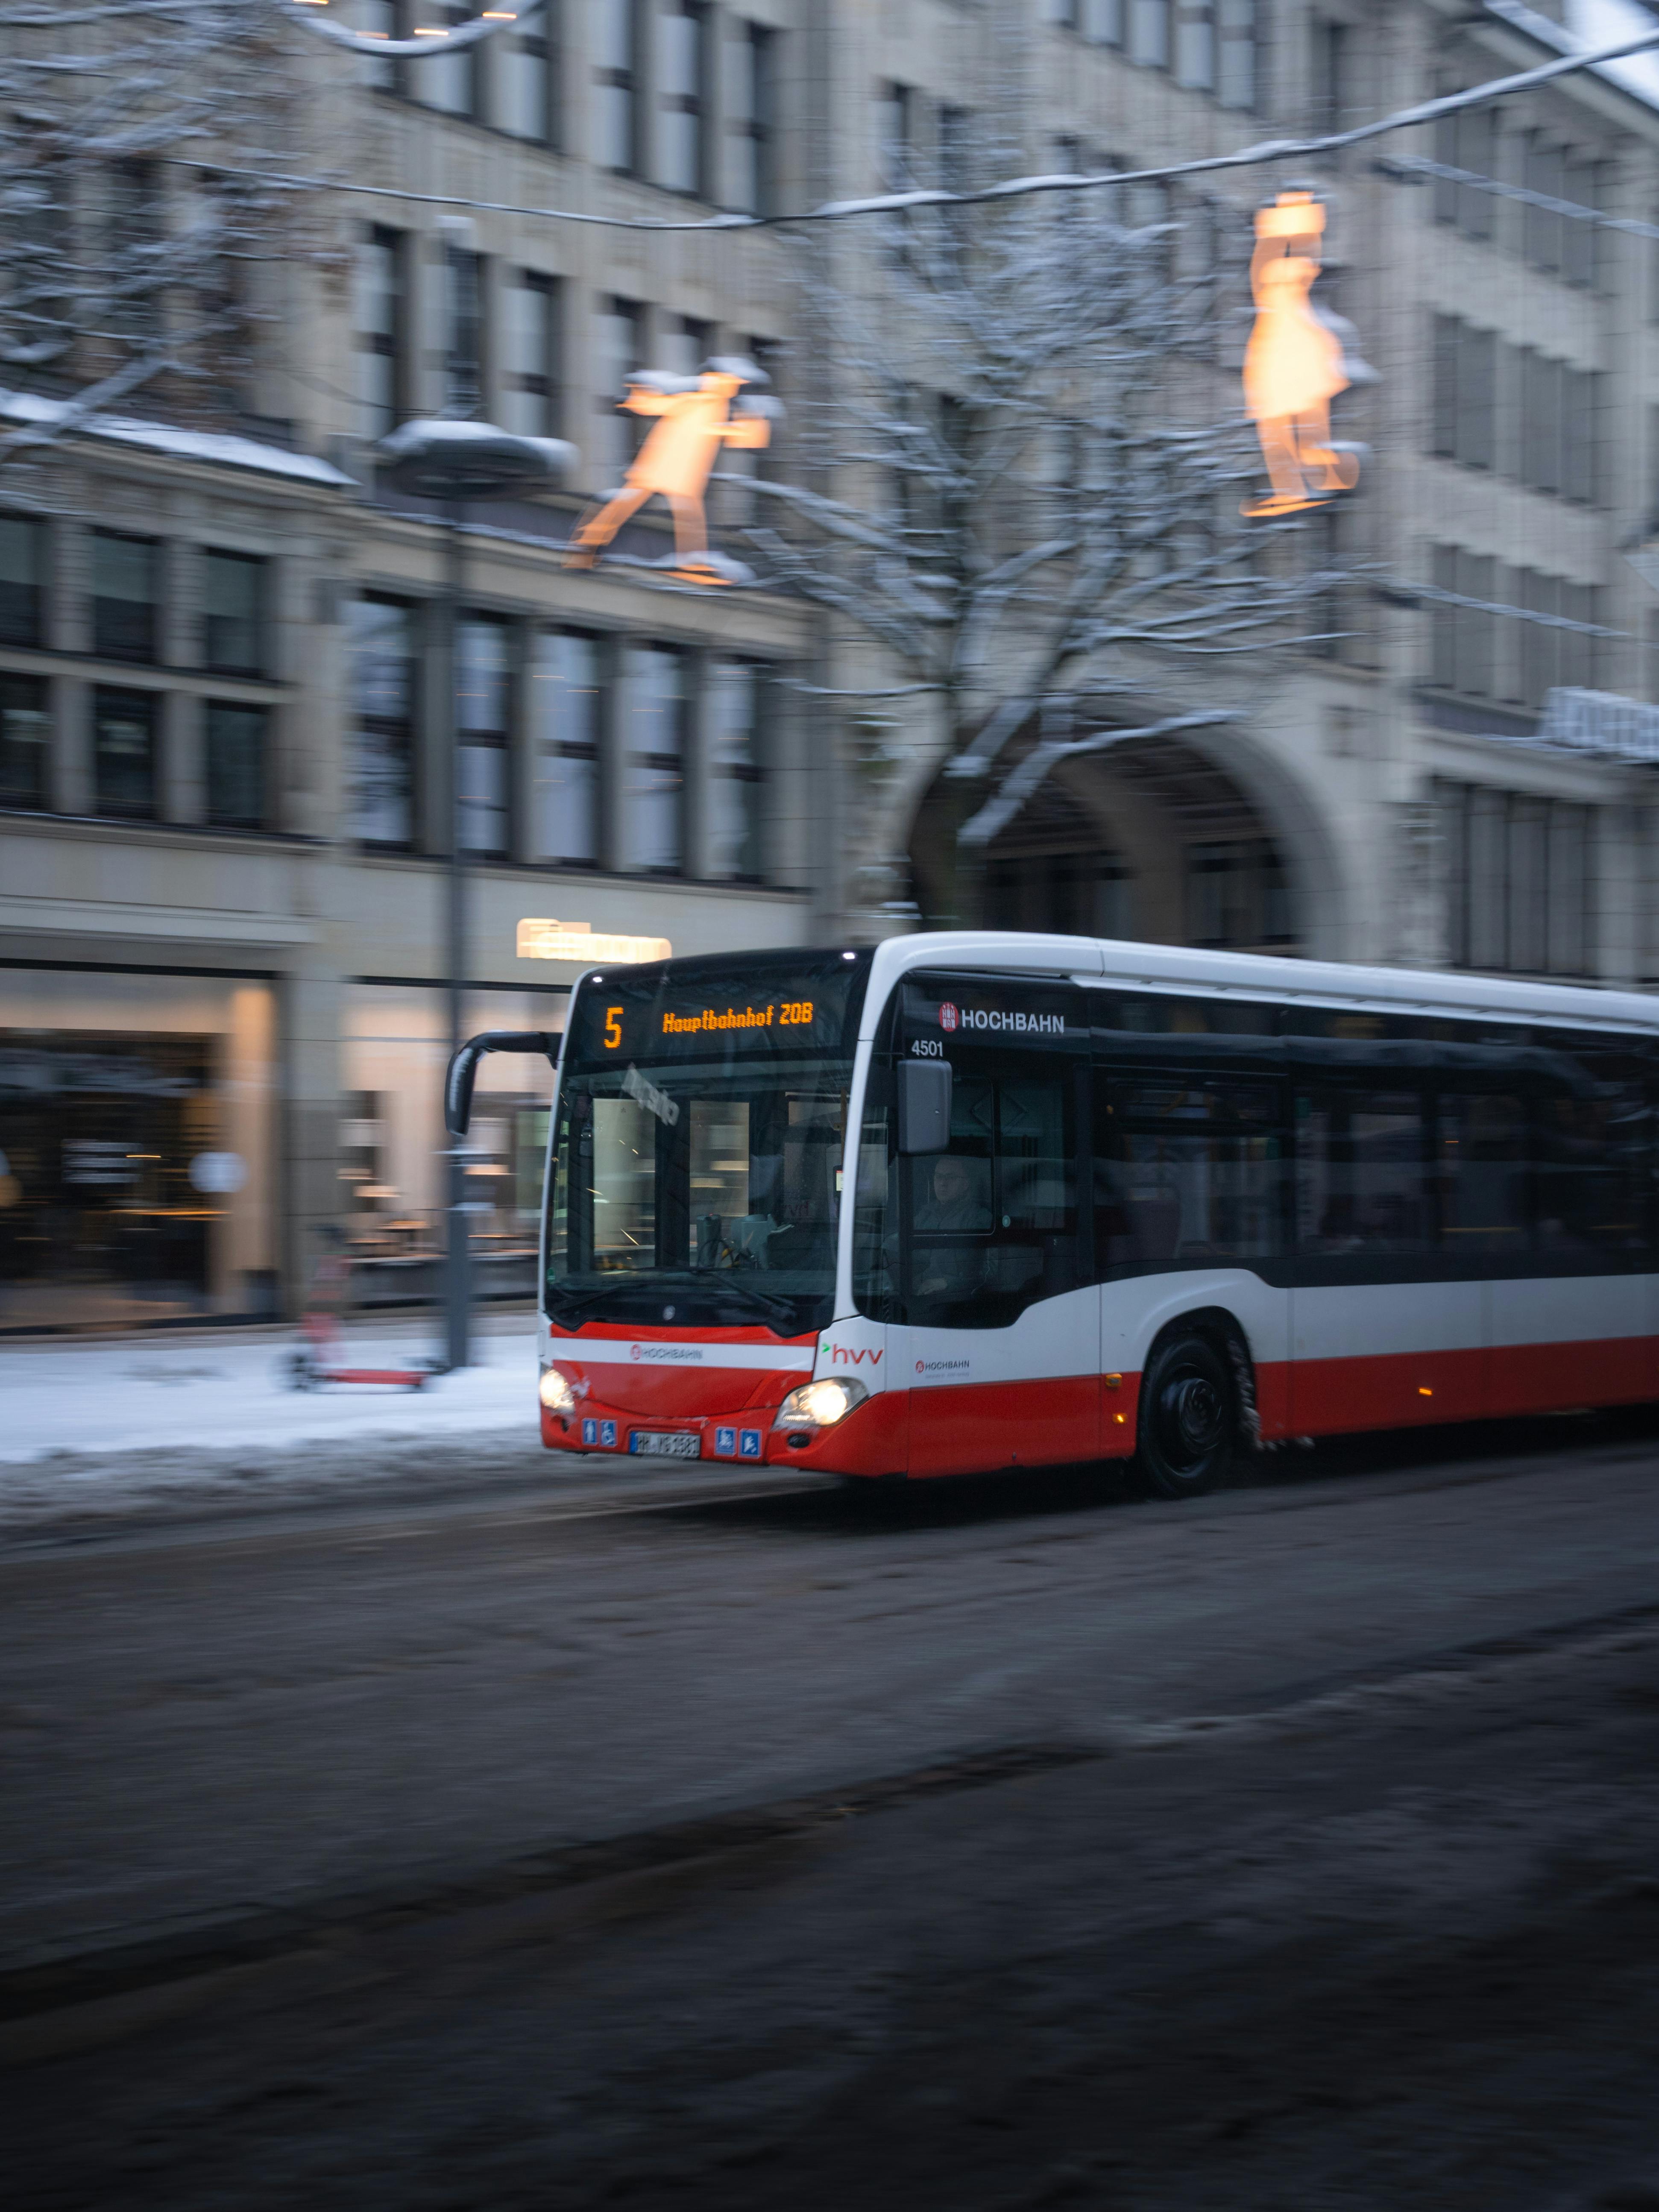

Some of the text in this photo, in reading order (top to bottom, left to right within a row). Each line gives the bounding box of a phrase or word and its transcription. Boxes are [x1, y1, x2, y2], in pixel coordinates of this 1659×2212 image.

[604, 1007, 624, 1049] 5
[662, 1005, 774, 1033] Hauptbahnhof
[961, 1009, 1065, 1034] HOCHBAHN
[911, 1040, 943, 1057] 4501
[642, 1348, 703, 1360] HOCHBAHN
[832, 1343, 884, 1365] hvv
[925, 1359, 970, 1371] HOCHBAHN
